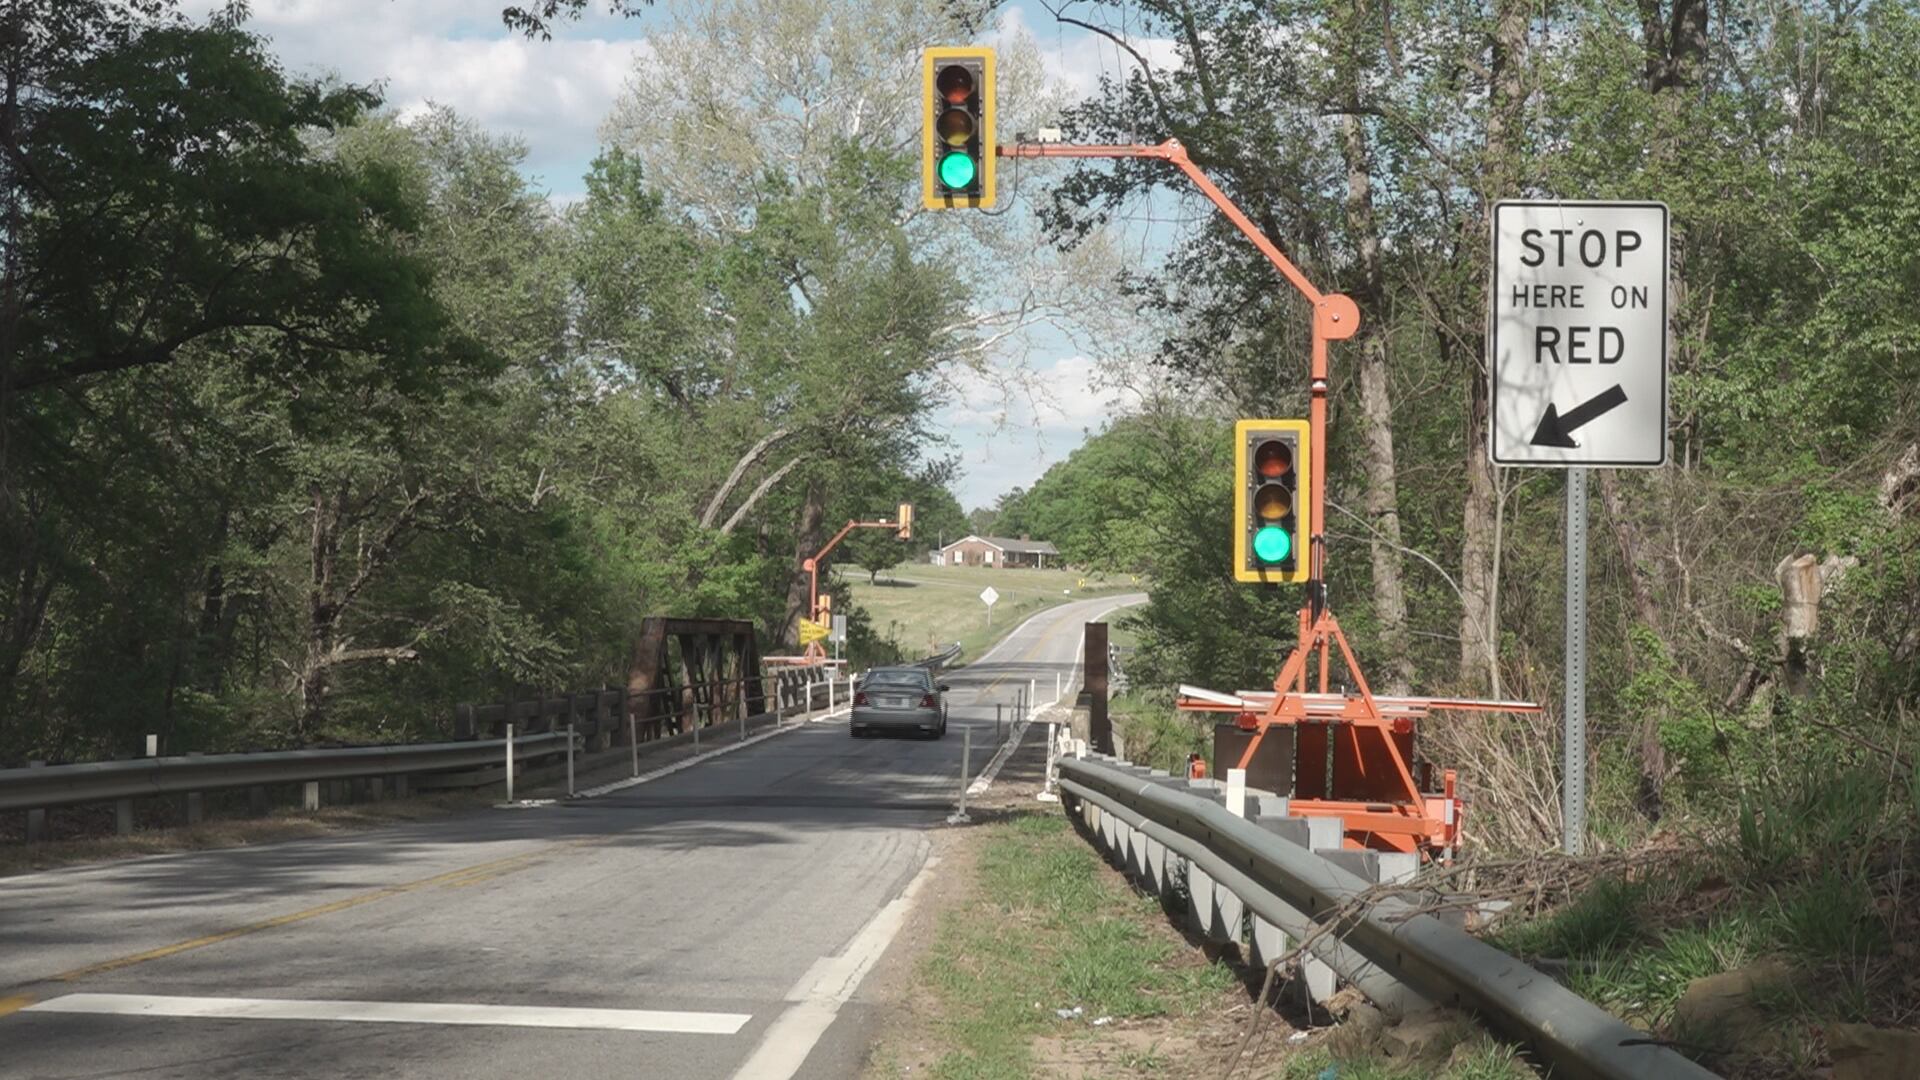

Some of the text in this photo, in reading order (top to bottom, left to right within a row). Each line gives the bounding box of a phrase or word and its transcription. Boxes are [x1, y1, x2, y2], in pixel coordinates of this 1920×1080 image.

[1520, 229, 1642, 268] STOP
[1513, 285, 1648, 309] HERE ON
[1535, 326, 1625, 364] RED
